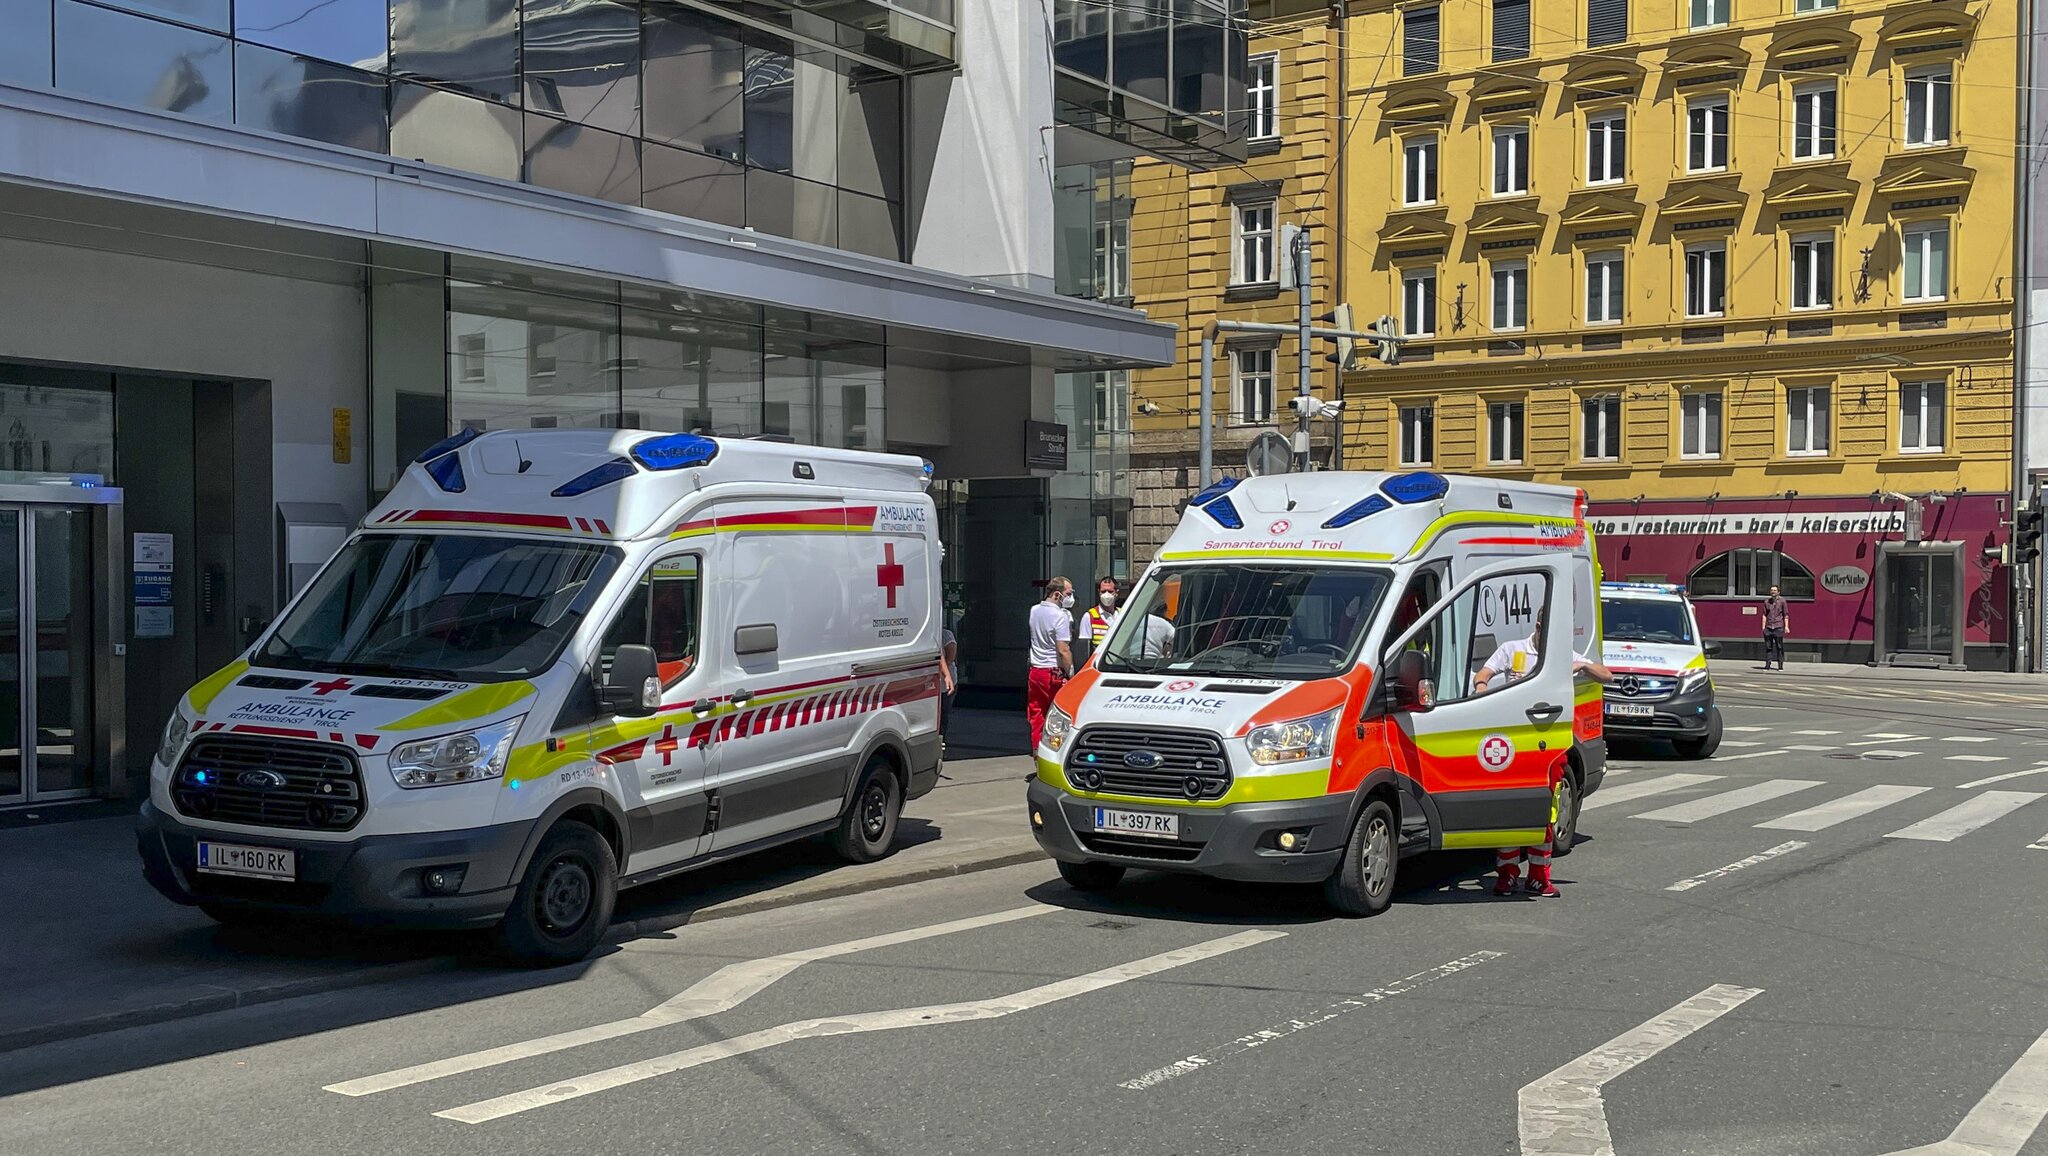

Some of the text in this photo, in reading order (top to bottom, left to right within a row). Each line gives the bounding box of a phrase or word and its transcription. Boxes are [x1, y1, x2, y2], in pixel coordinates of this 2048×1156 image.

[880, 505, 926, 521] AMBULANCE
[1635, 518, 1727, 534] restaurant
[1749, 518, 1779, 533] bar
[1800, 515, 1905, 533] kaiserstub
[1203, 540, 1344, 550] Samariterbund Tirol
[1499, 583, 1532, 625] 144
[1602, 653, 1665, 662] MBULANCE
[390, 679, 469, 690] RD 13-160
[1102, 703, 1217, 715] RETTUNGSDIENST TIROL
[1108, 694, 1226, 709] AMBULANCE
[236, 702, 356, 722] AMBULANCE
[1614, 705, 1650, 715] IL 179 RK
[228, 712, 340, 729] RETTUNGSDIENST TIROL
[560, 773, 571, 783] RD
[1108, 812, 1119, 827] IL
[1128, 816, 1152, 830] 397
[1155, 817, 1171, 832] RK
[216, 847, 228, 865] IL
[240, 850, 264, 869] 160
[268, 853, 286, 872] RK
